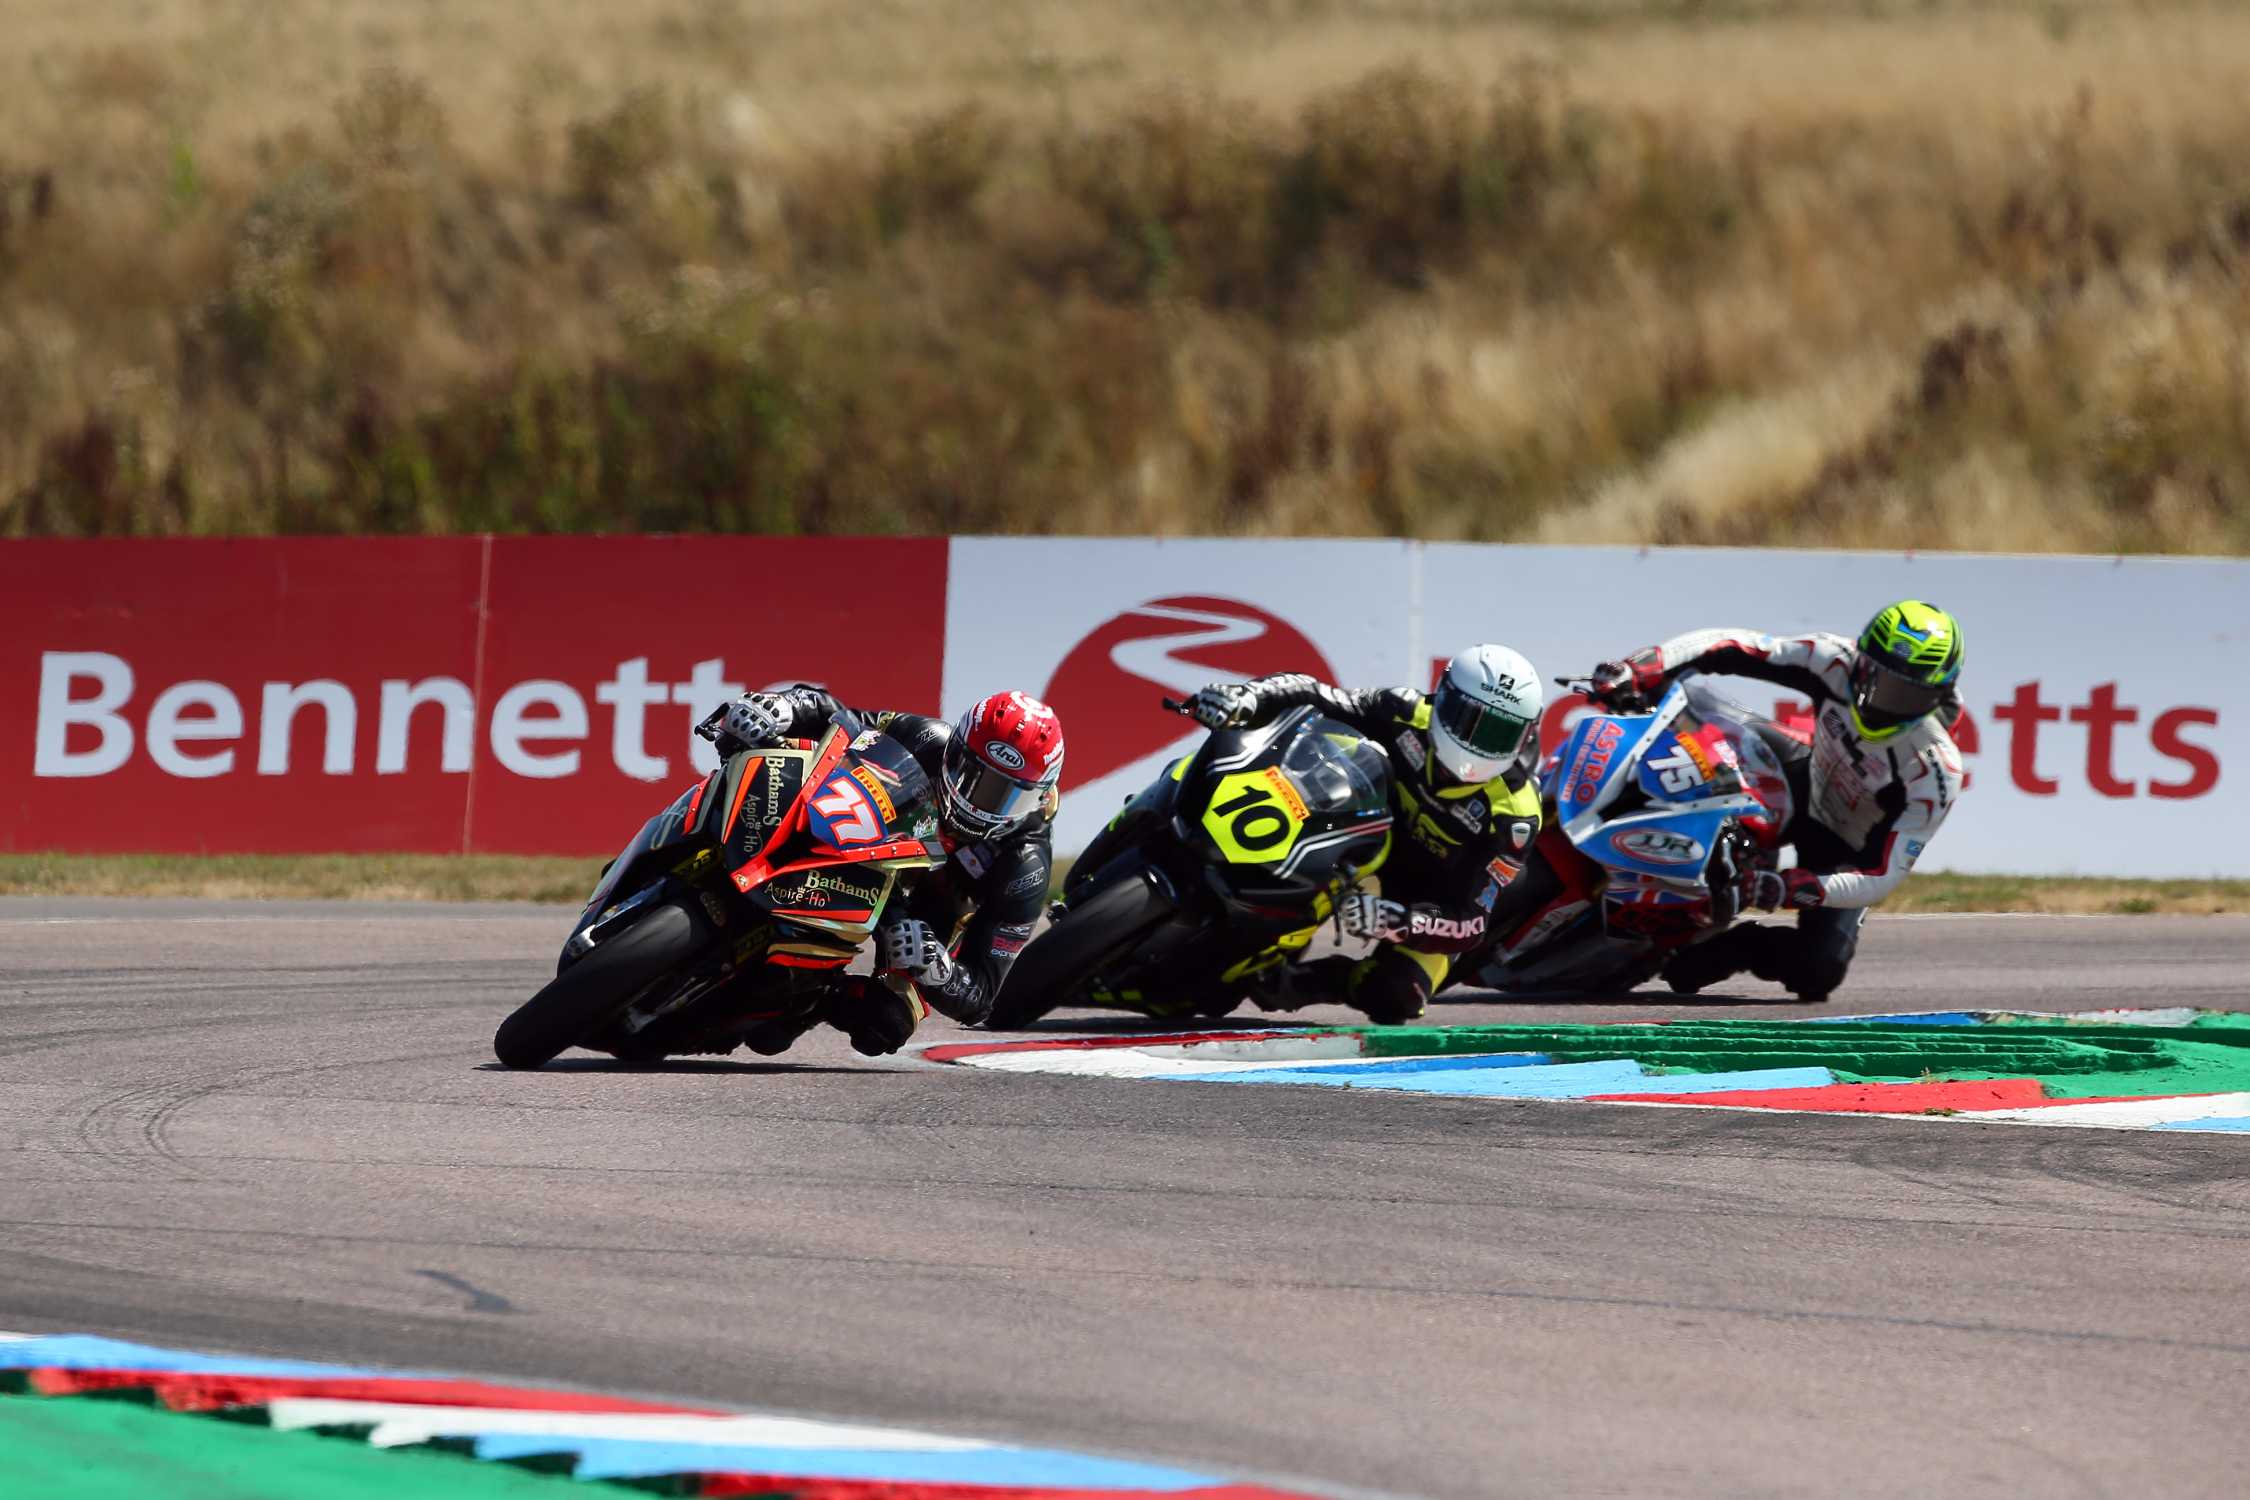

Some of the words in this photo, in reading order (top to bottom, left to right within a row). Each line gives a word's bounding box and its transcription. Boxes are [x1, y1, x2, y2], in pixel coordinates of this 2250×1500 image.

[34, 650, 827, 782] Bennett
[1481, 682, 1523, 705] SHARK
[989, 743, 1020, 766] Arai
[1576, 720, 1625, 804] ASTRO
[1648, 745, 1705, 794] 75
[810, 776, 883, 846] 77
[852, 767, 895, 821] PIRELLI
[1213, 785, 1290, 852] 10
[1411, 915, 1485, 939] SUZUKI
